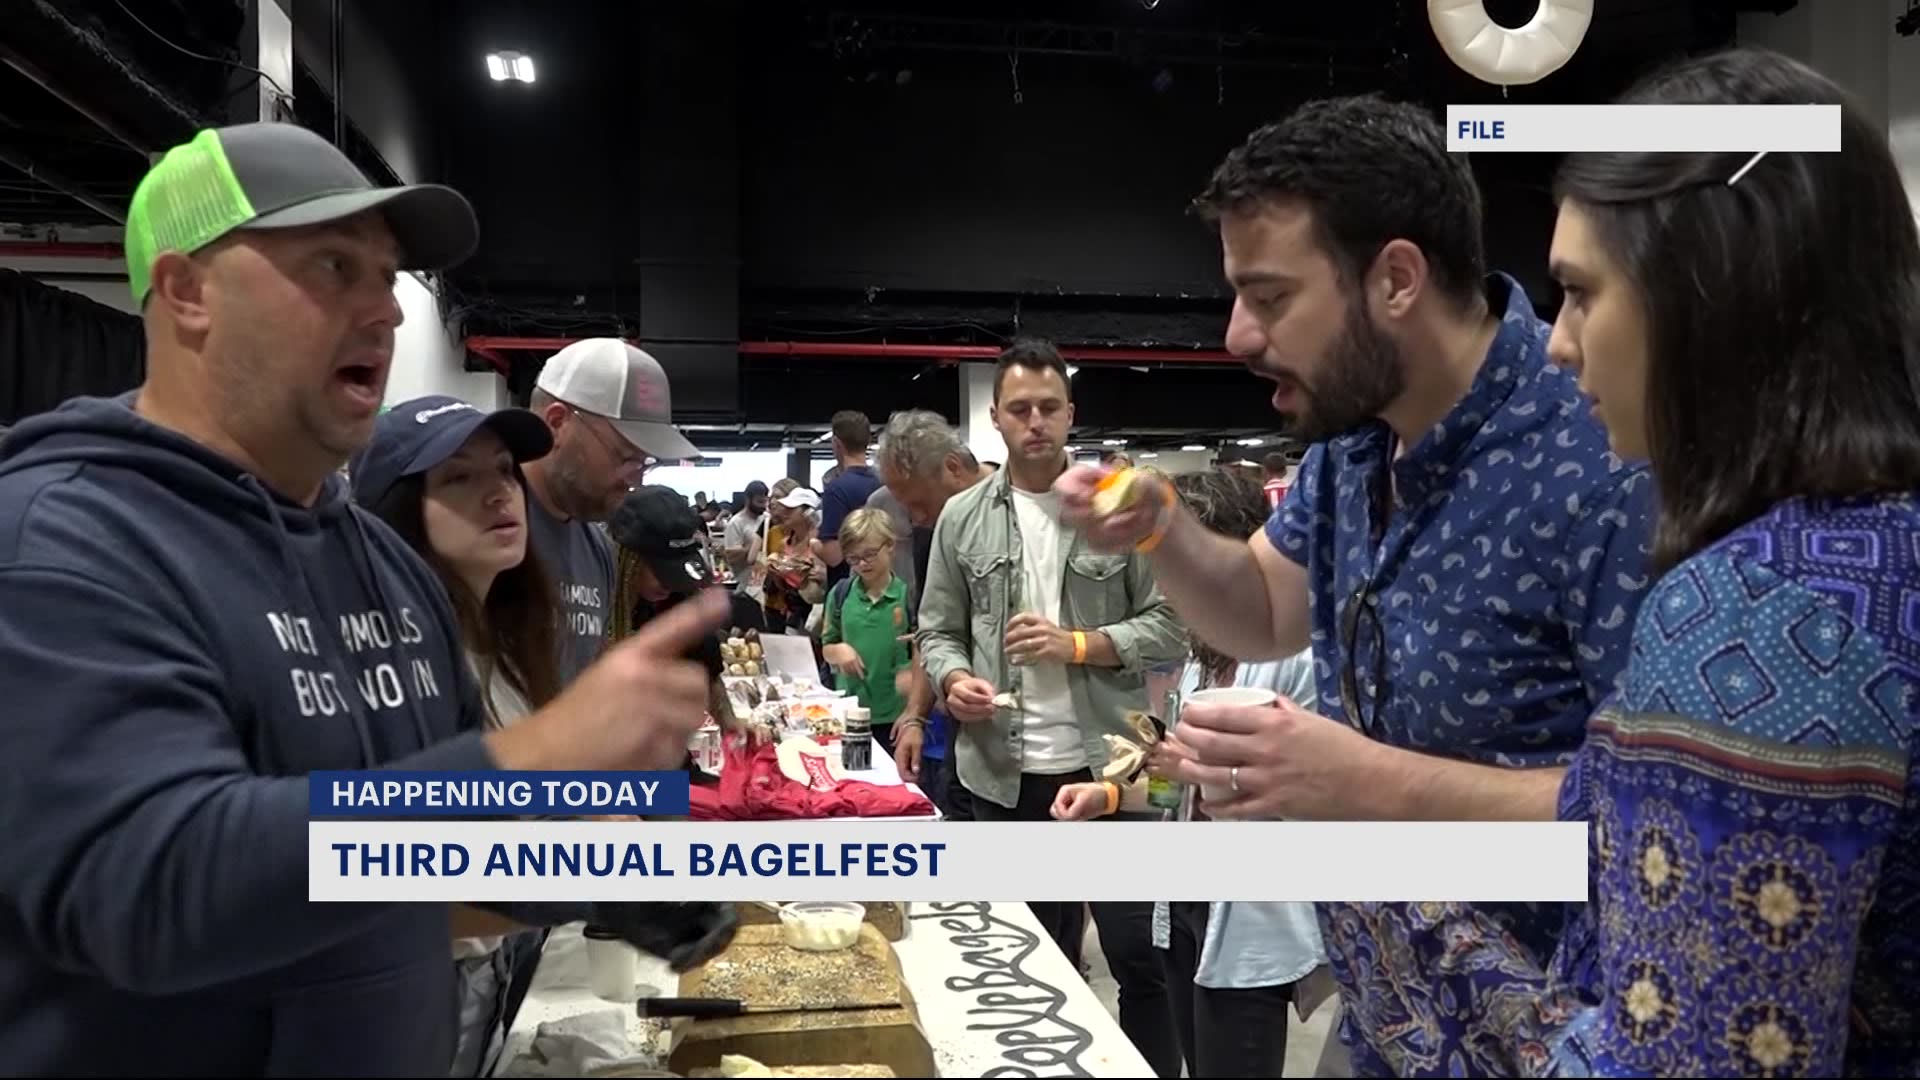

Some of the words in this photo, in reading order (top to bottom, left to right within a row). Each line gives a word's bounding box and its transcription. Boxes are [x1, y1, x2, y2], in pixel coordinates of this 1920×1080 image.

[559, 581, 602, 609] AMOUS
[339, 606, 424, 654] AMOS
[556, 607, 603, 637] NOWN
